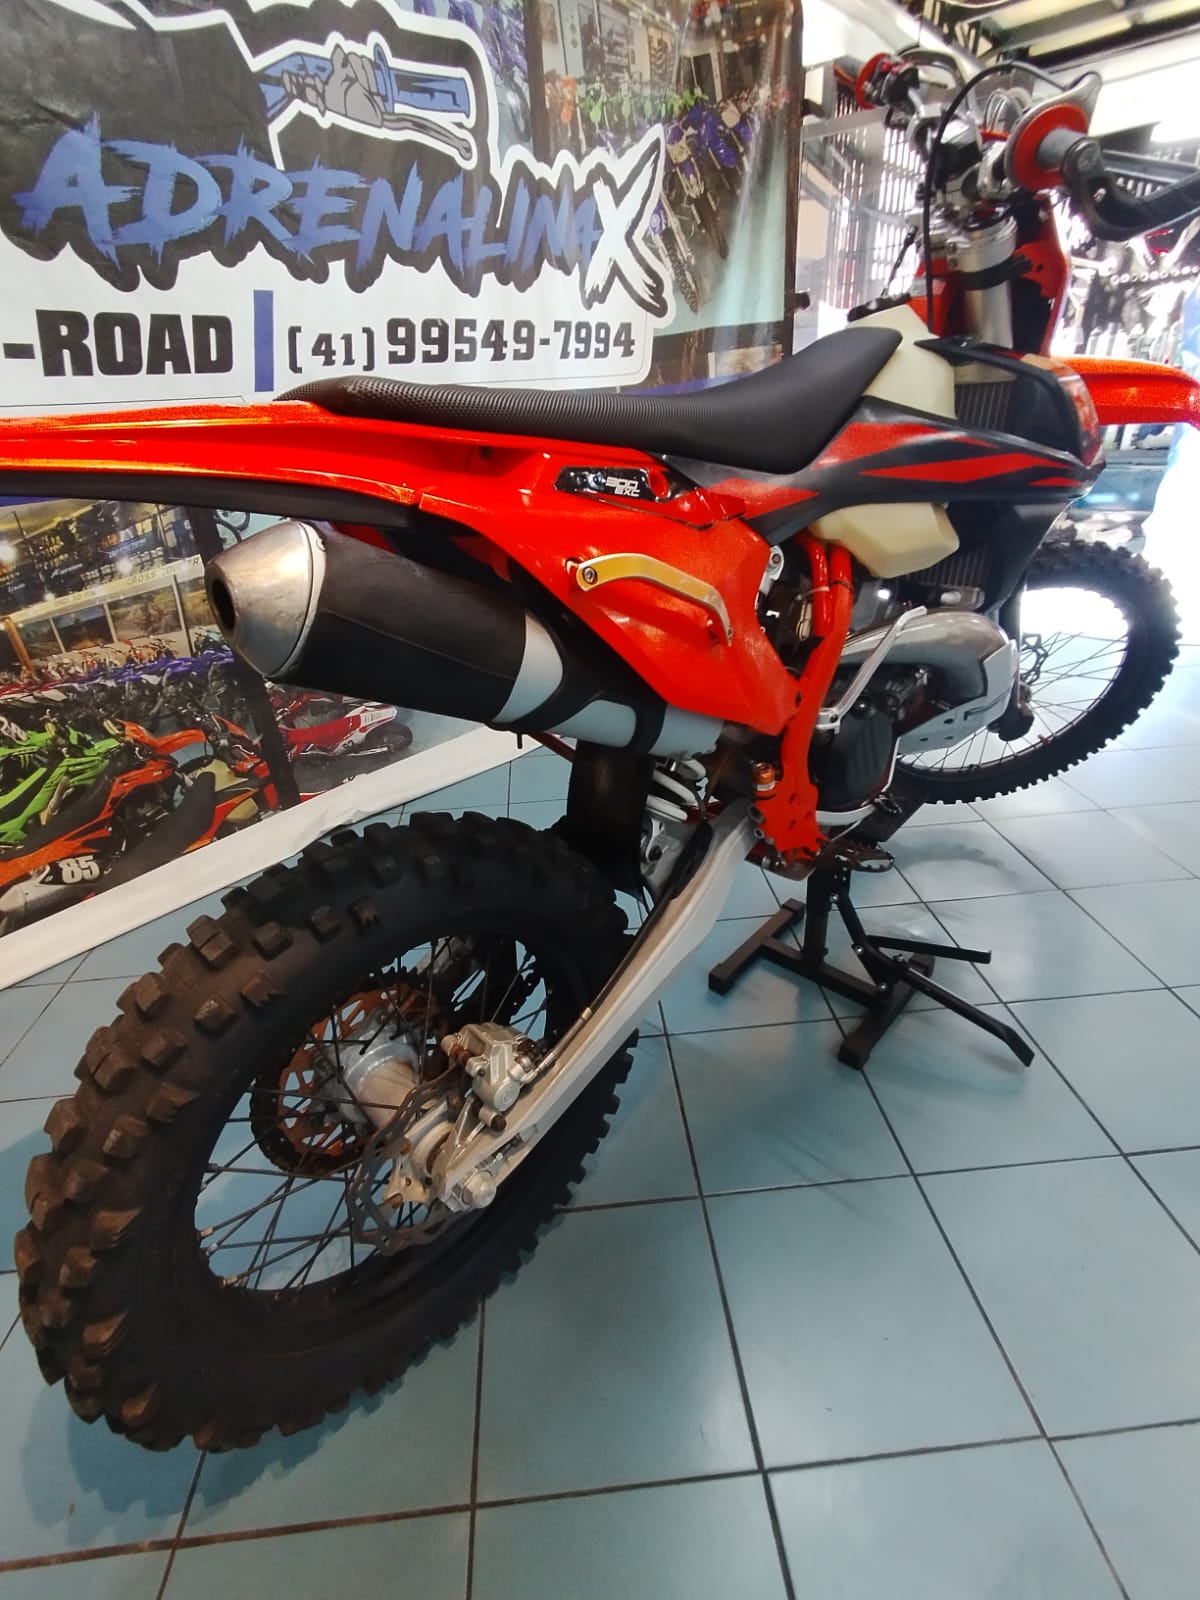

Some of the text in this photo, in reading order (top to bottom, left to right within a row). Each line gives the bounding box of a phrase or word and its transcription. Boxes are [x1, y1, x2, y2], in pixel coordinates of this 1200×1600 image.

[3, 309, 636, 377] -ROAD (41) 99549-7994
[606, 476, 639, 490] 300
[614, 486, 640, 497] EXC
[58, 854, 100, 884] 85
